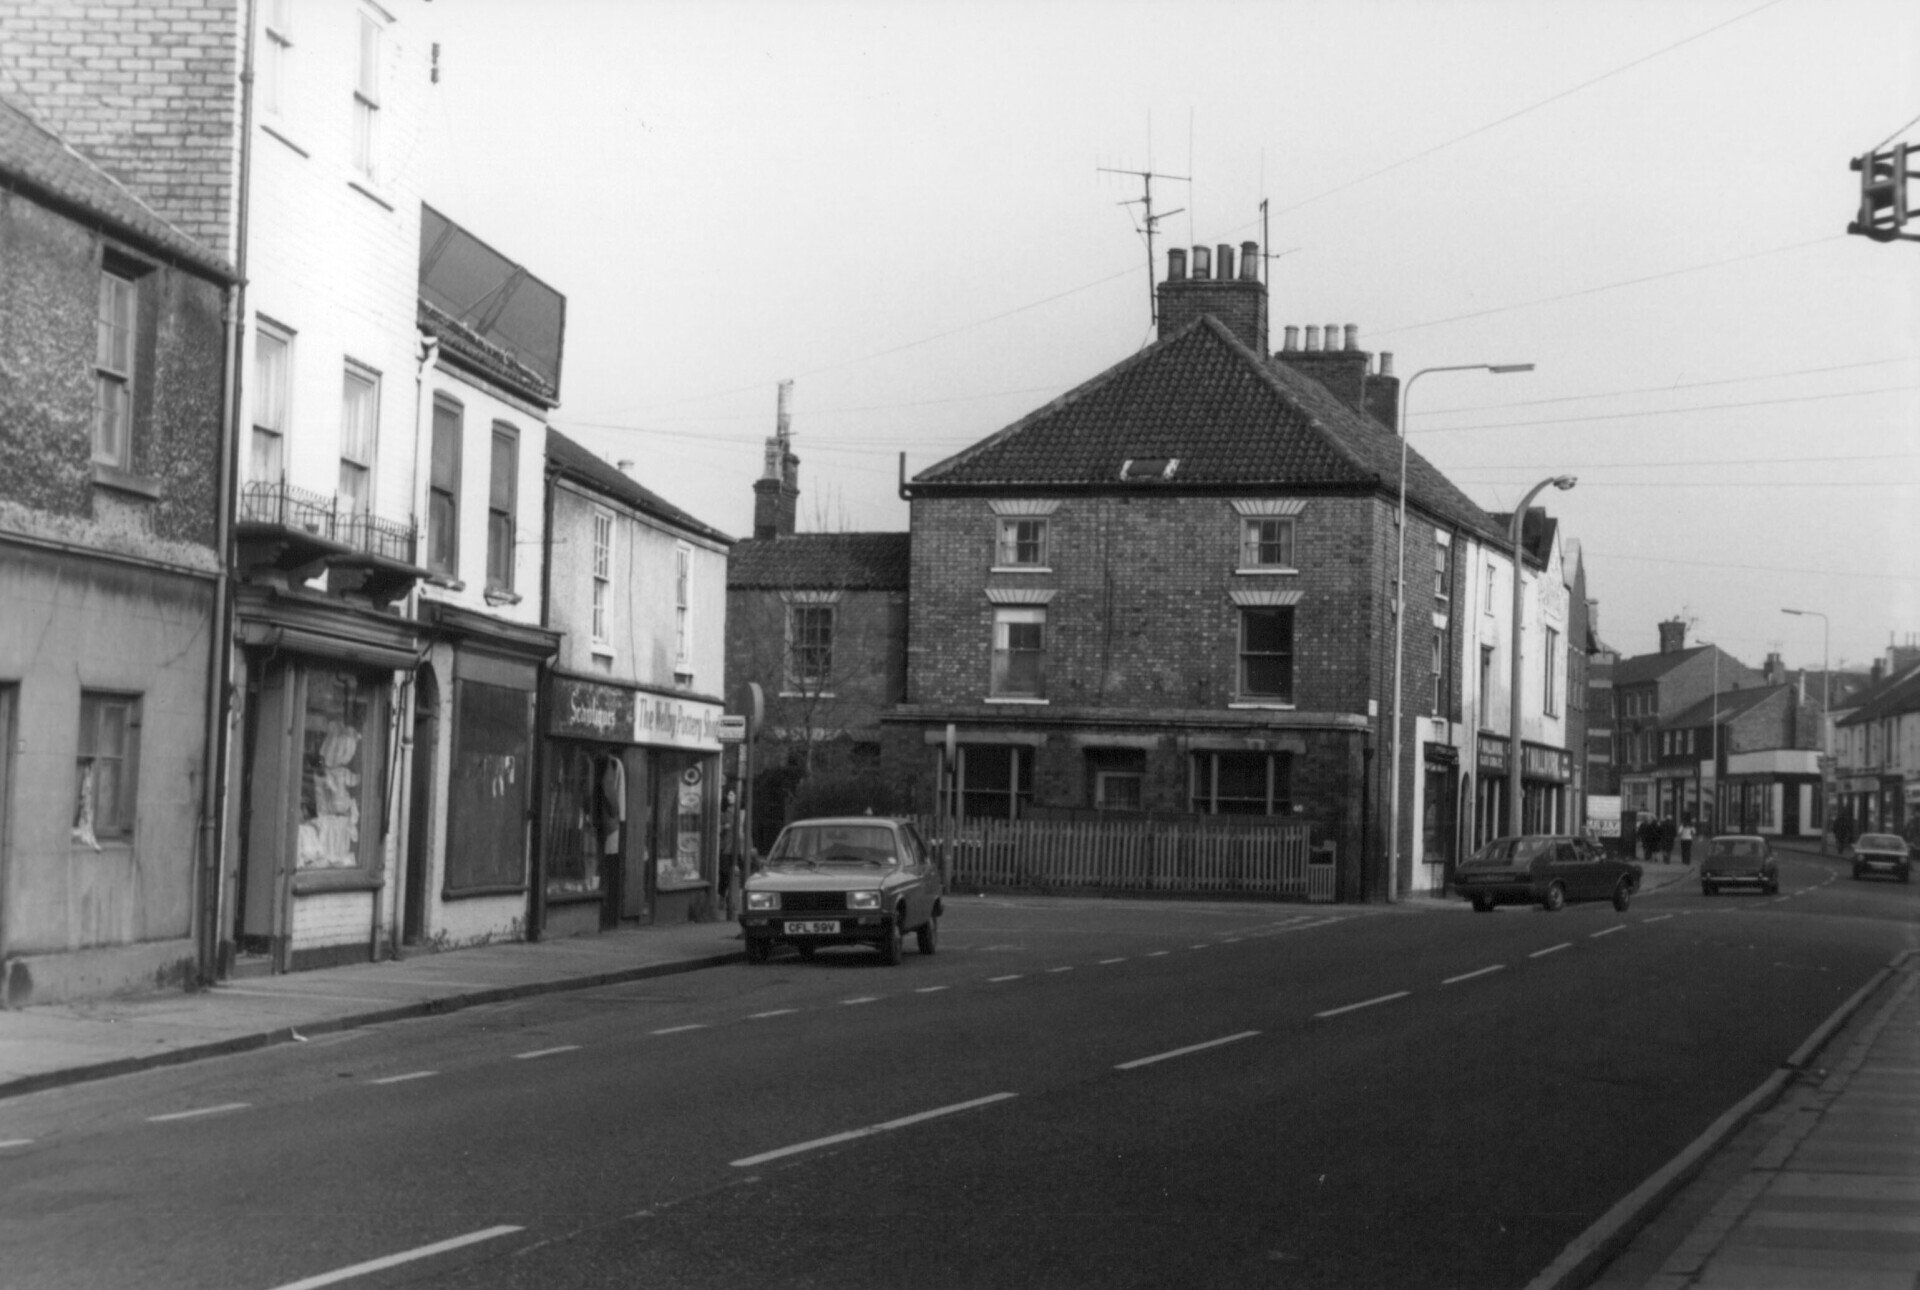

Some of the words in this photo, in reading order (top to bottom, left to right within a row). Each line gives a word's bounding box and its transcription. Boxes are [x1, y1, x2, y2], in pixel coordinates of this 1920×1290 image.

[640, 698, 654, 731] The
[788, 922, 811, 933] CFL
[813, 922, 835, 933] 59V
